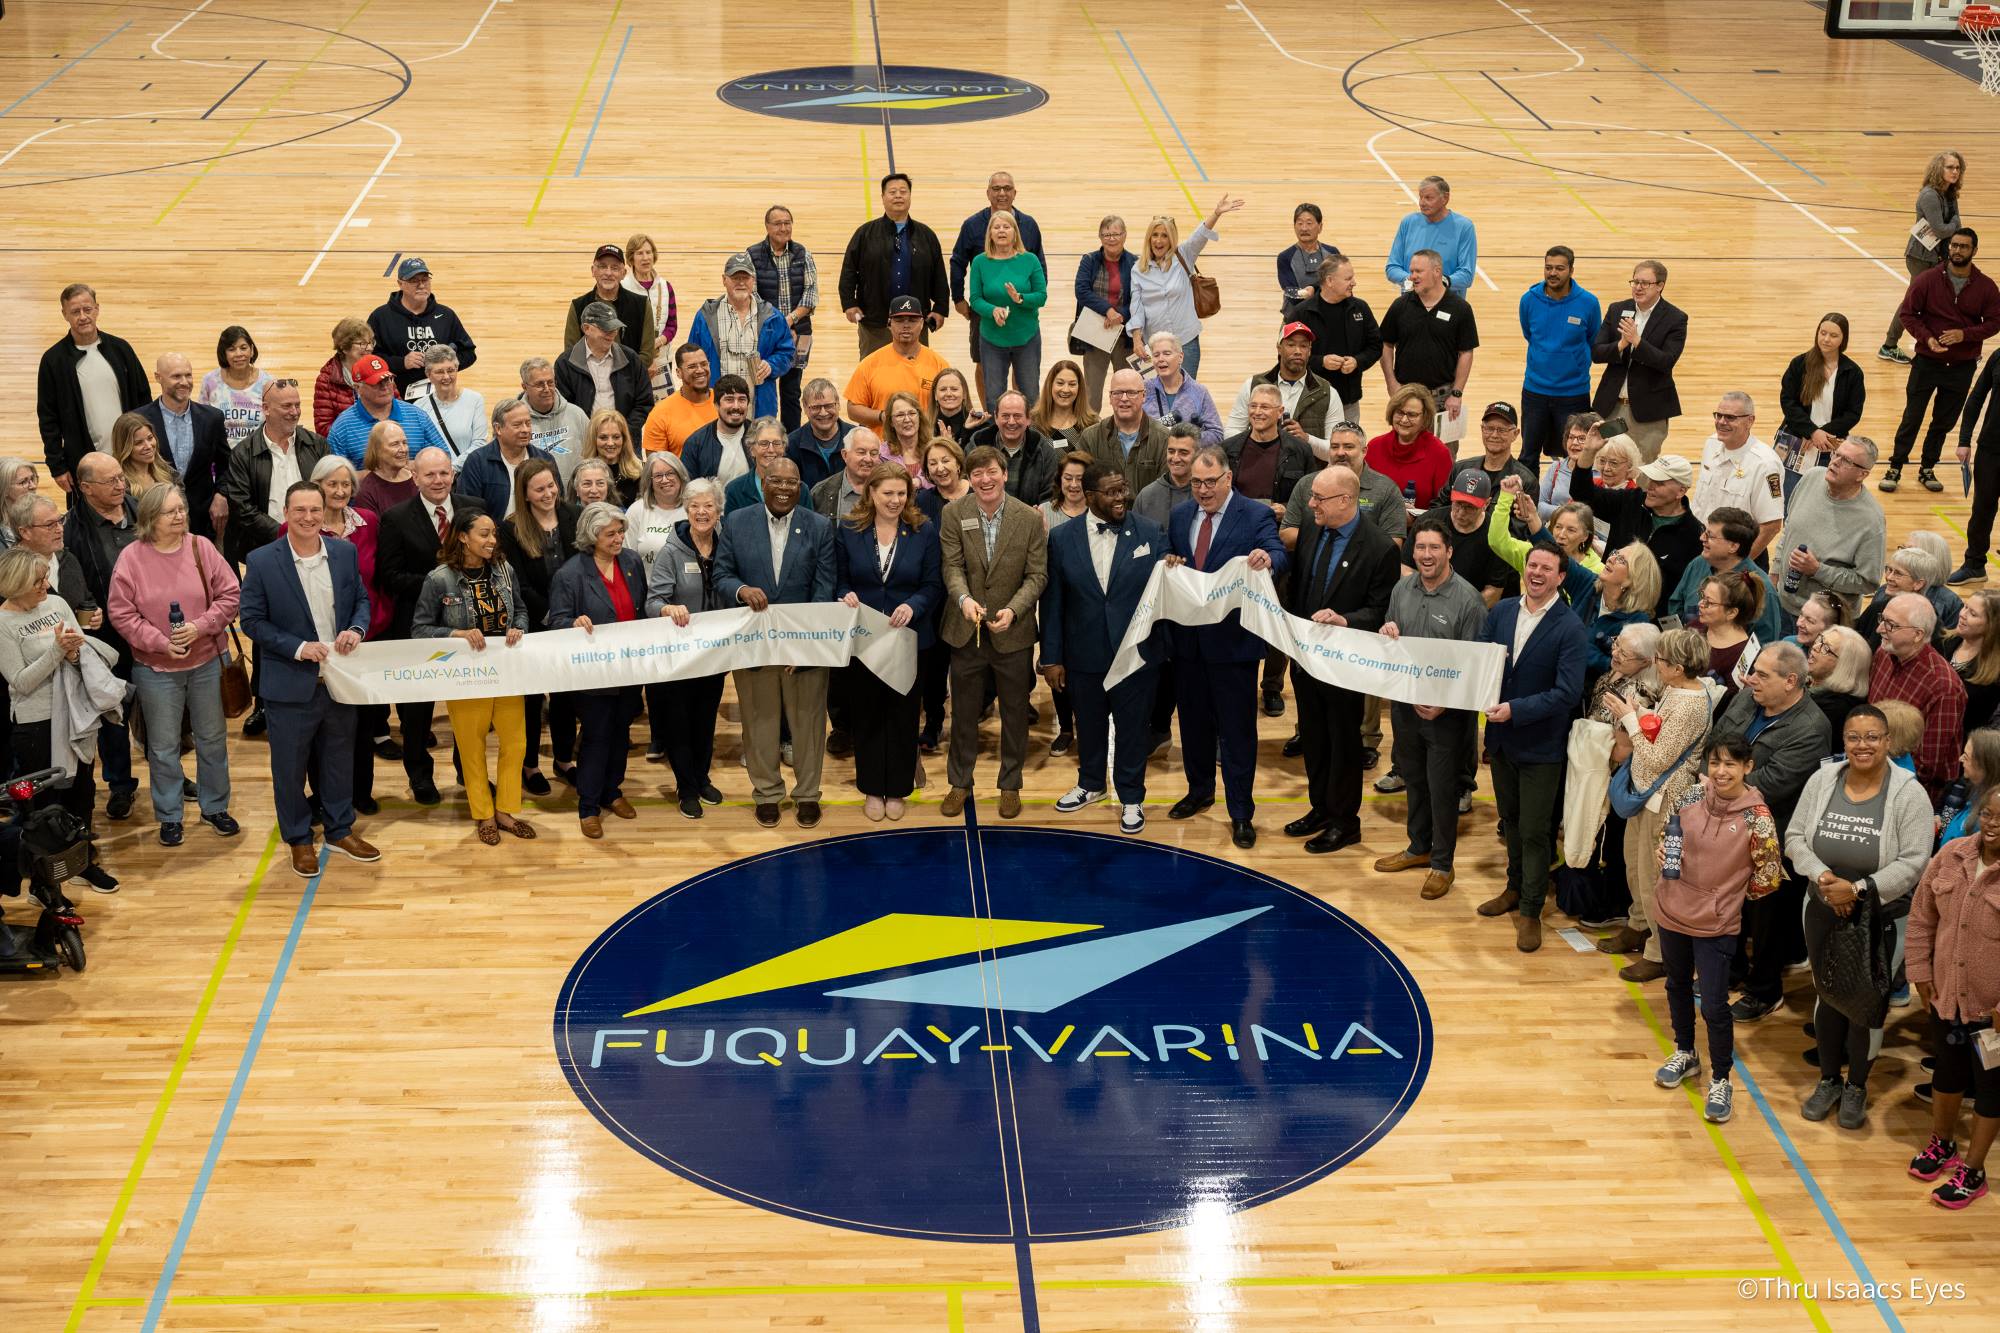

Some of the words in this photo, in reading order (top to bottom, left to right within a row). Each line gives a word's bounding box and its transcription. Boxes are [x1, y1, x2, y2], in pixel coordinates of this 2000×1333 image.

[407, 326, 435, 340] USA
[225, 408, 261, 422] EOPLE
[646, 523, 674, 534] meet
[571, 650, 616, 664] Hilltop
[620, 642, 690, 659] Needmore
[694, 638, 730, 650] Town
[735, 630, 764, 644] Park
[768, 628, 846, 642] Community
[1313, 644, 1344, 661] Park
[1348, 653, 1424, 679] Community
[1425, 665, 1462, 680] Center
[383, 666, 499, 681] FUQUAY-VARINA
[1827, 812, 1874, 825] STRONG
[1826, 821, 1851, 831] THE
[1853, 826, 1881, 837] NEW
[1819, 830, 1870, 845] PRETTY.
[589, 1022, 1405, 1069] FUQUAY-VARINA
